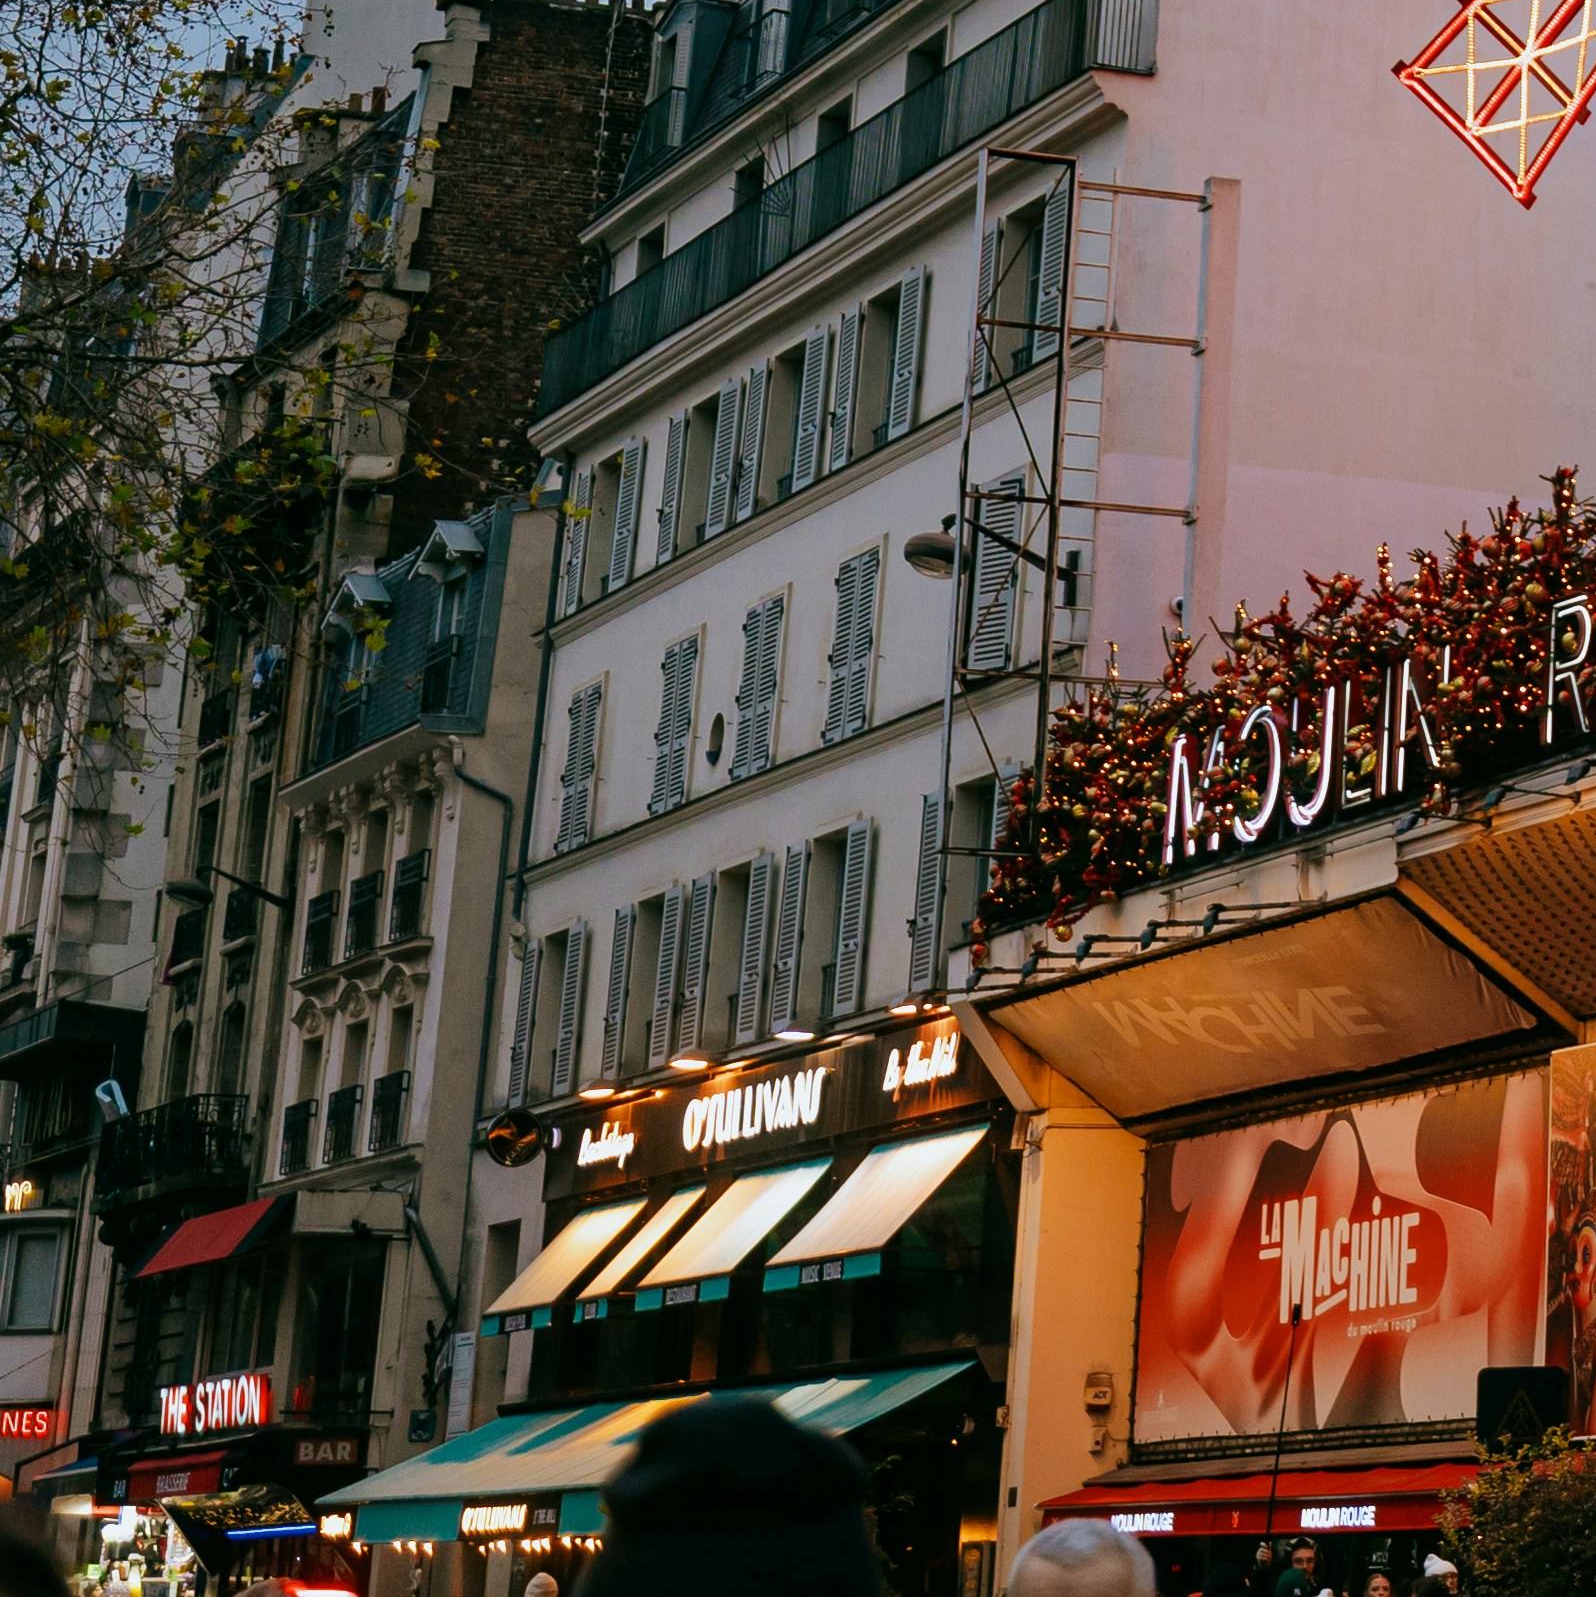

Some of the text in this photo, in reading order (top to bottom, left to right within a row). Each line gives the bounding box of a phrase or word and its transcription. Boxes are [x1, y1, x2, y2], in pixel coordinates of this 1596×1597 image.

[1260, 1202, 1281, 1245] LA
[160, 1374, 261, 1435] THE STATION
[1092, 1391, 1108, 1400] ADT
[2, 1411, 48, 1433] NES
[300, 1441, 351, 1461] BAR
[113, 1479, 127, 1499] BAR
[1301, 1505, 1376, 1529] MOULIN ROUGE
